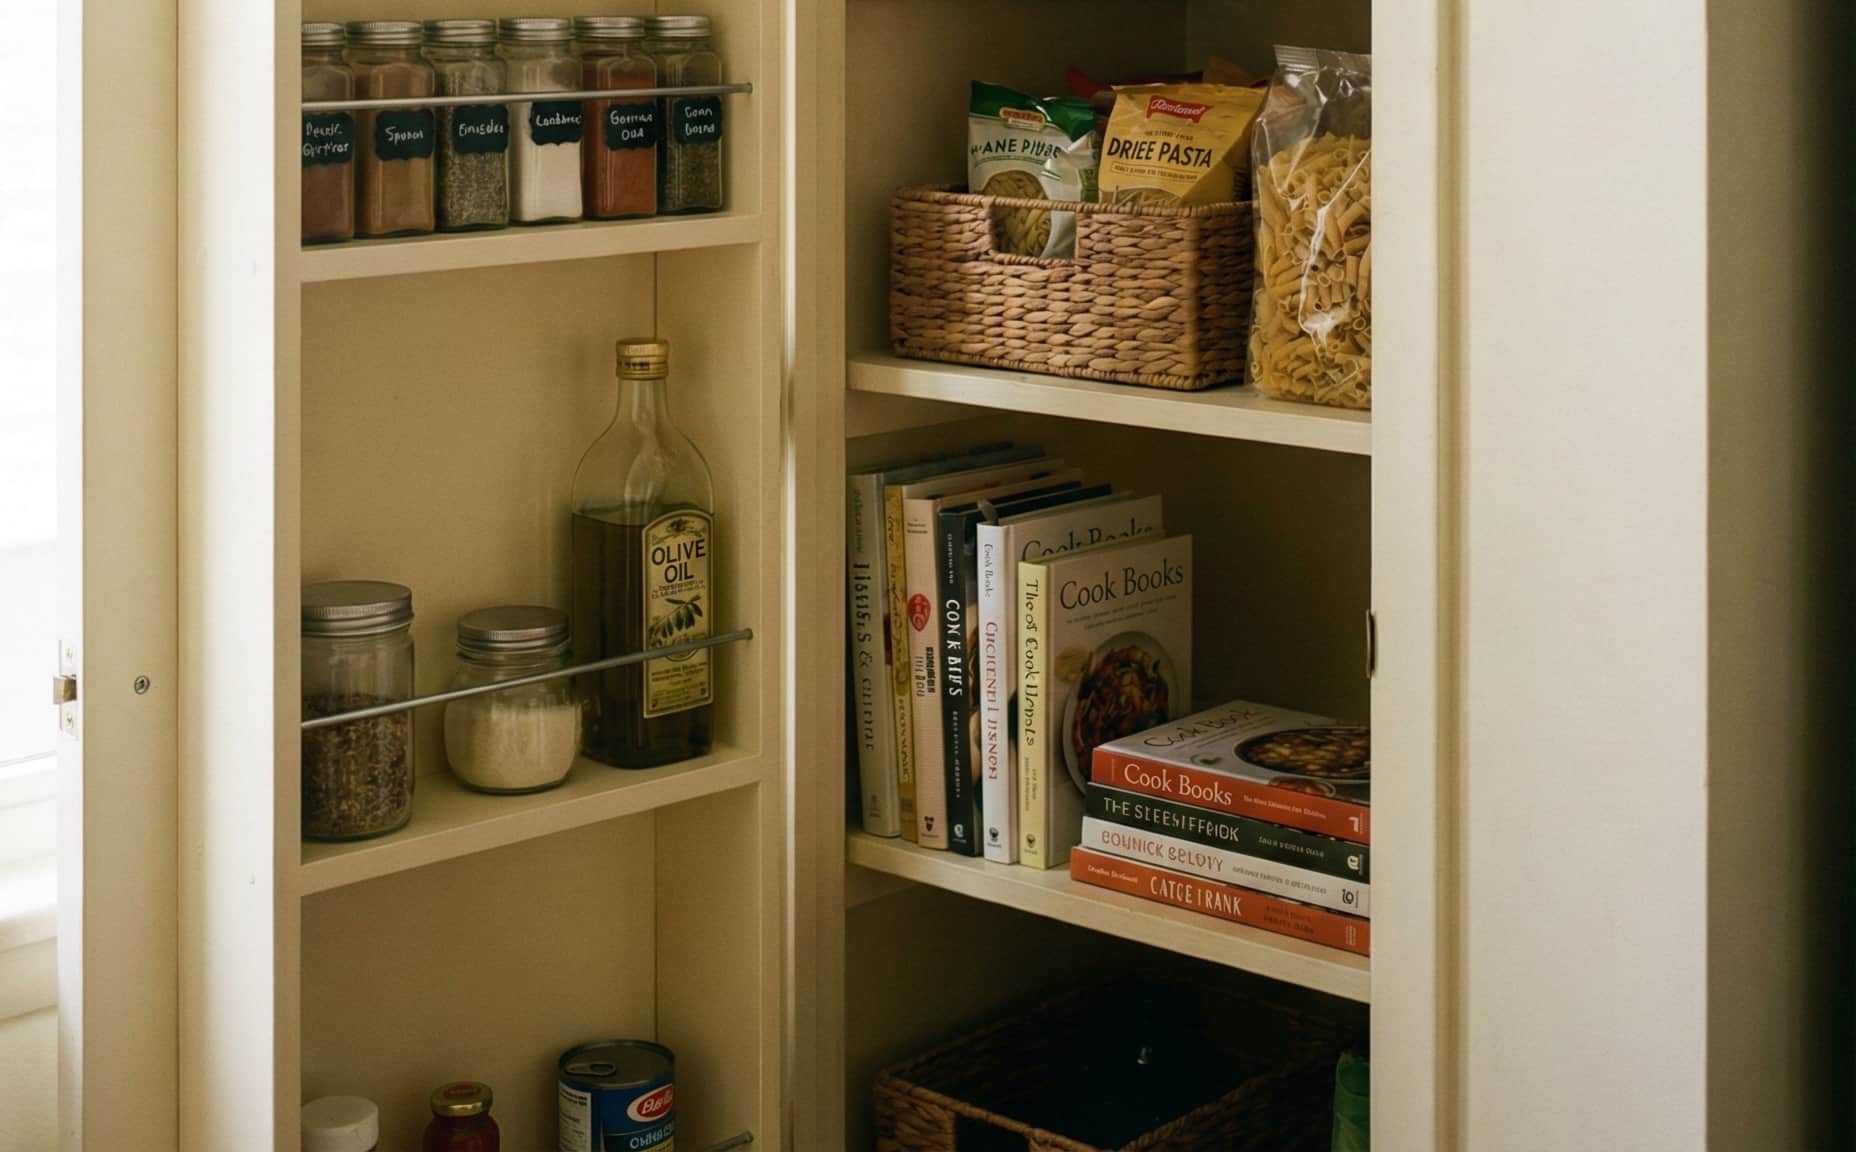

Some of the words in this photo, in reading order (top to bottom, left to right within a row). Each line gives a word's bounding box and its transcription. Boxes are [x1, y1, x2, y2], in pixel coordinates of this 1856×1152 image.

[1158, 142, 1213, 168] PASTA
[651, 539, 706, 566] OLIVE
[664, 562, 694, 584] OIL
[1060, 571, 1117, 610] Cook
[1122, 558, 1184, 596] Books
[1124, 763, 1172, 793] Cook
[1178, 774, 1233, 806] Books
[1104, 797, 1130, 817] THE
